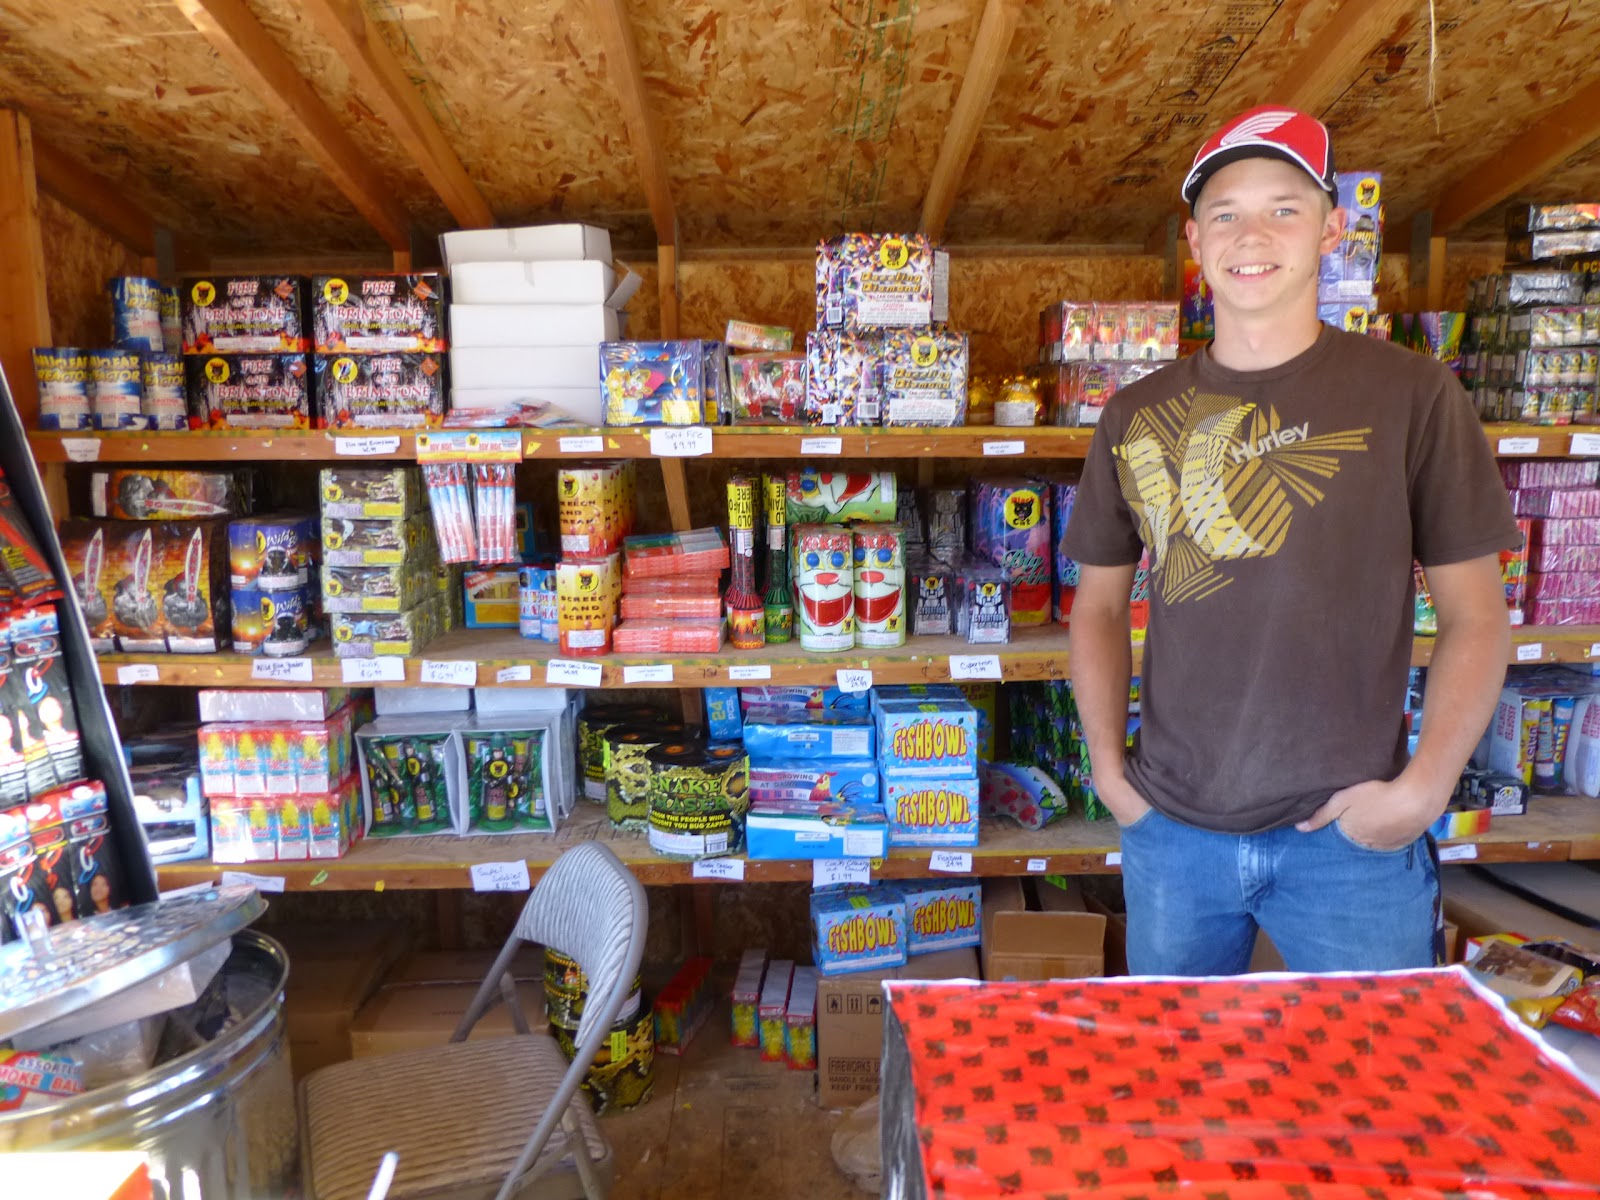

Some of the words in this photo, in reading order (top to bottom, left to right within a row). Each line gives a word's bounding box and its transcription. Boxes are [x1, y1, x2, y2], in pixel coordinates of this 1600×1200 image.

[861, 271, 922, 283] Dazzling
[227, 281, 259, 296] FIRE
[362, 281, 396, 295] FIRE
[862, 283, 921, 293] Diamond
[205, 307, 286, 321] BRIMSTONE
[336, 306, 423, 321] BRIMSTONE
[241, 360, 273, 374] FIRE
[371, 358, 402, 372] FIRE
[894, 368, 952, 380] Dazzling
[219, 385, 300, 399] BRIMSTONE
[346, 383, 431, 398] BRIMSTONE
[894, 380, 952, 390] Diamond
[1231, 421, 1310, 464] Hurley
[1013, 518, 1031, 526] Cat
[802, 534, 851, 552] JOKER
[854, 534, 897, 550] OKER
[1001, 549, 1044, 573] Big
[256, 664, 271, 672] Wild
[709, 700, 727, 721] 24
[777, 773, 814, 781] CROWING
[650, 774, 722, 795] SNAKE
[674, 821, 688, 829] YOU
[680, 815, 708, 823] PEOPLE
[708, 813, 725, 821] WHO
[831, 1060, 871, 1072] FIREWORKS
[0, 1067, 42, 1086] MOKE
